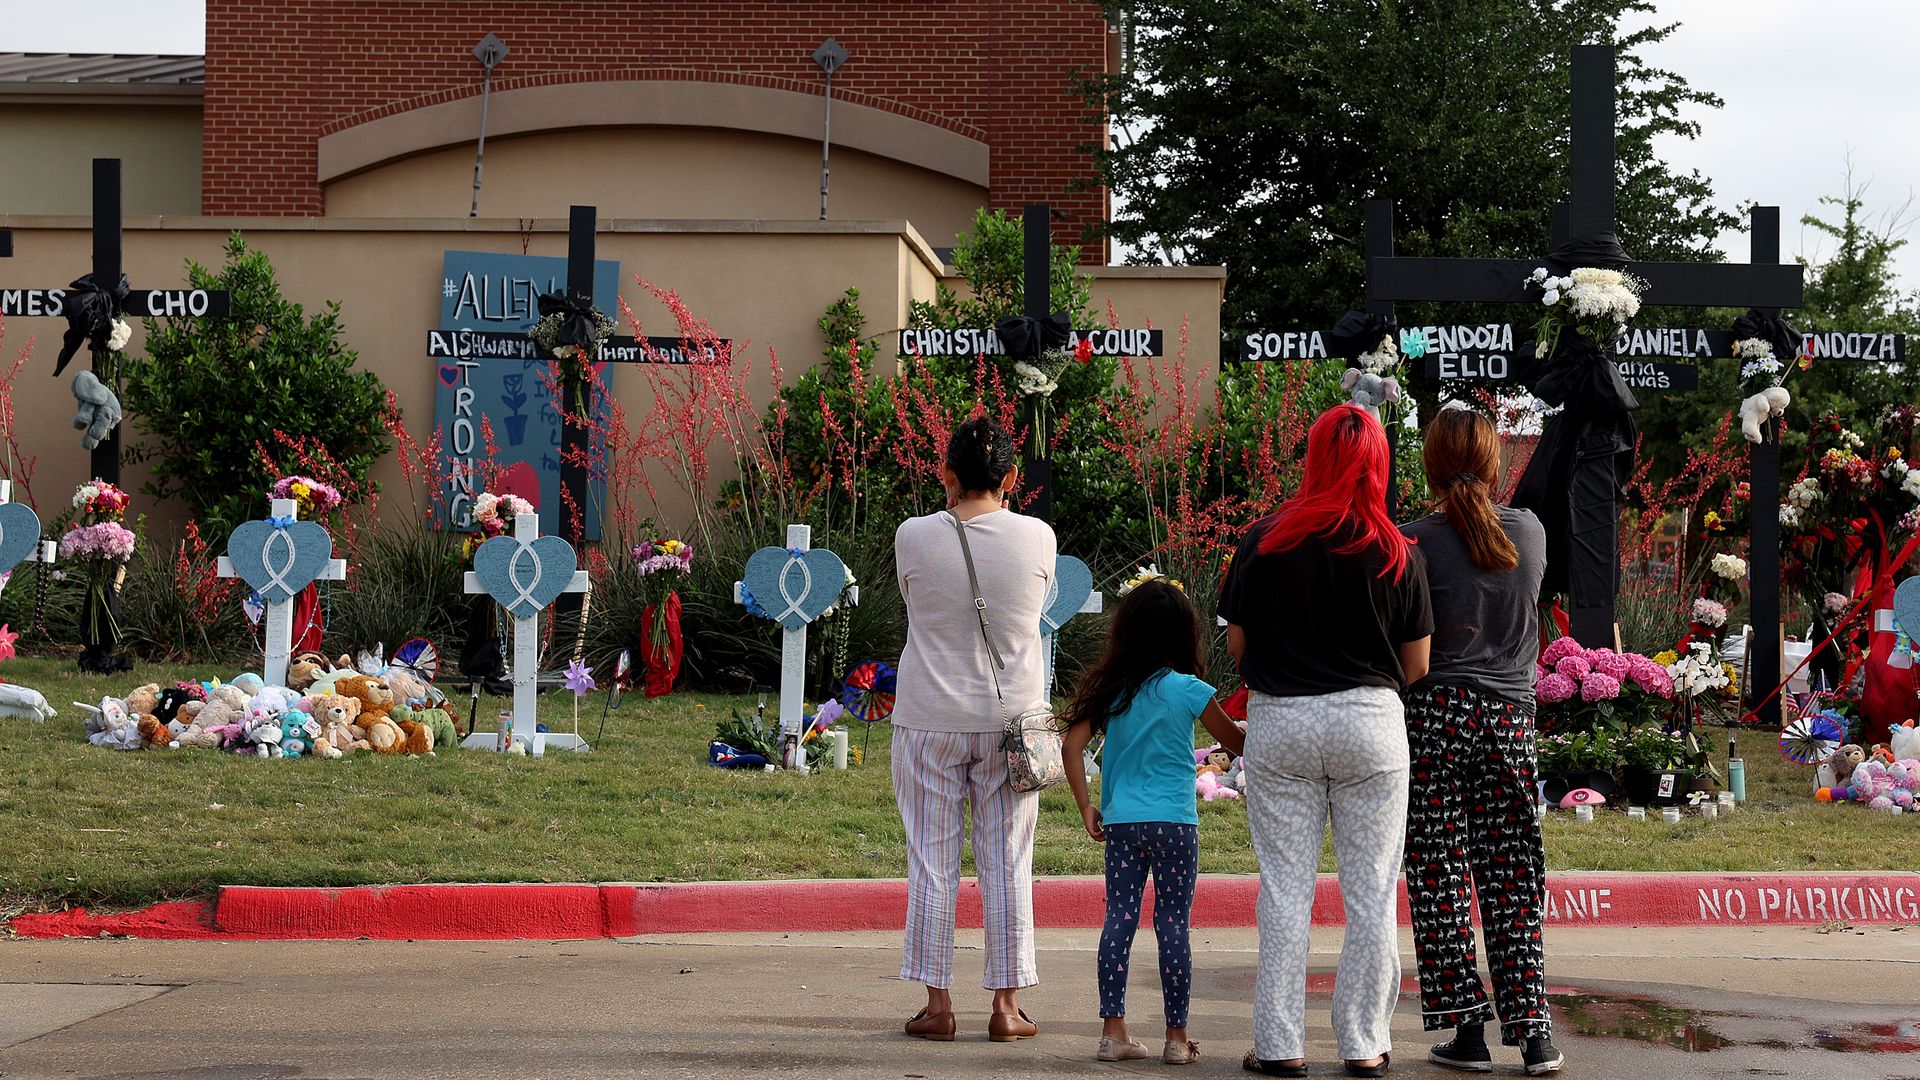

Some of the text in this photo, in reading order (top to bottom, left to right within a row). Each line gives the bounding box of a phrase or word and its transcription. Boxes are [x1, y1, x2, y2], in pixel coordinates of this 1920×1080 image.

[0, 288, 209, 317] MES CHO
[1697, 887, 1747, 920] NO
[1757, 887, 1920, 920] PARKING
